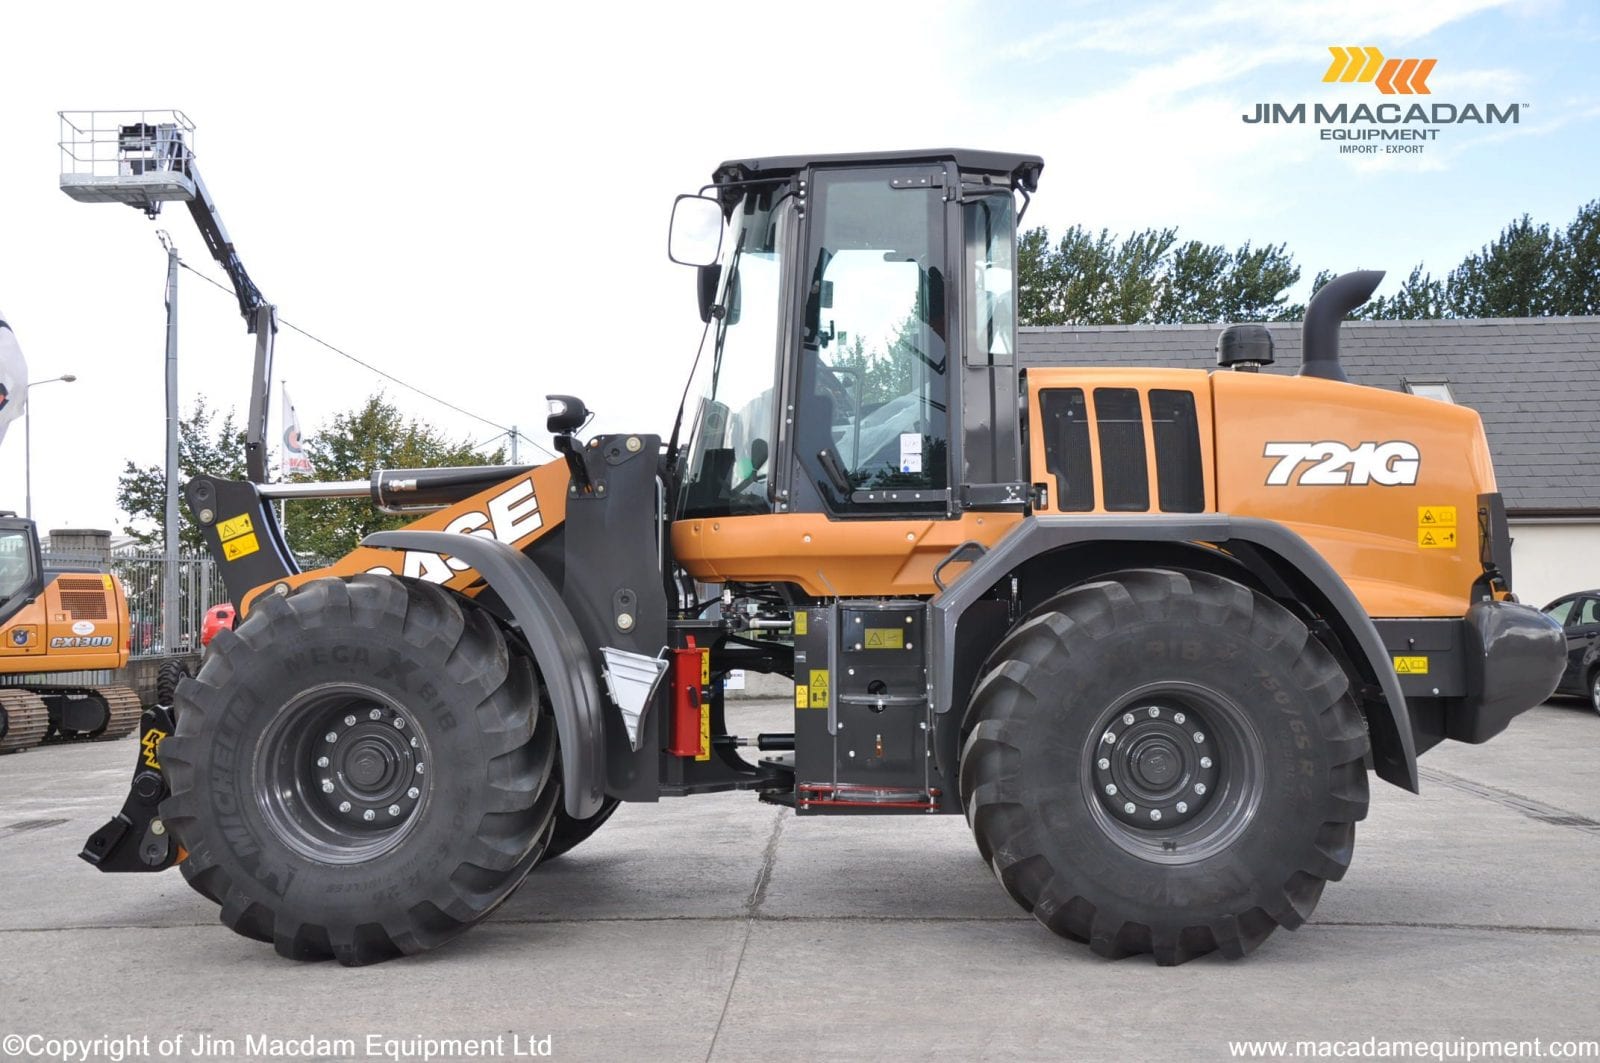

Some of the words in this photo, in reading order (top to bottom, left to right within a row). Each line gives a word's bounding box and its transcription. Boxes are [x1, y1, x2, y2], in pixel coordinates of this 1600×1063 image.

[1262, 440, 1421, 487] 721G
[364, 476, 543, 585] ASE
[212, 687, 259, 859] MICHELIN
[283, 646, 371, 674] MEGA
